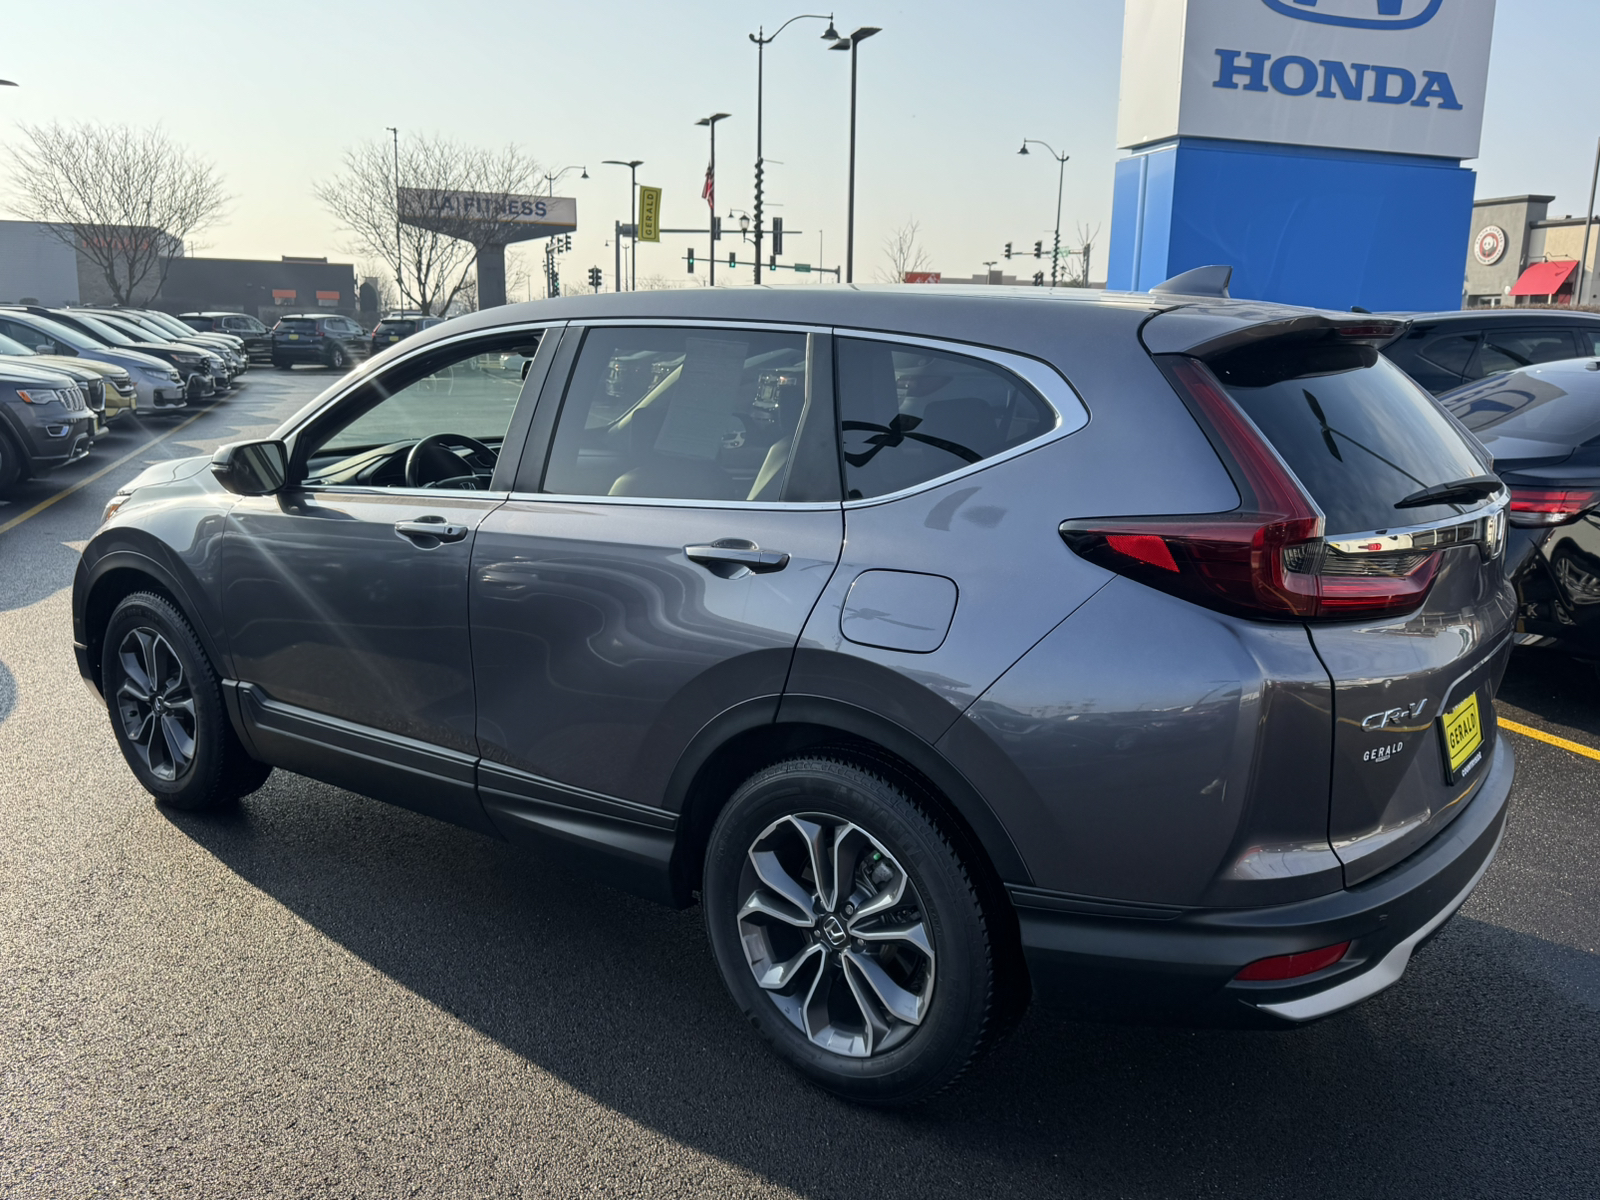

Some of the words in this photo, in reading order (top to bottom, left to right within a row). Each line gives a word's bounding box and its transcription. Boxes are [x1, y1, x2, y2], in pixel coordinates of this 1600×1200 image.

[1212, 48, 1463, 111] HONDA
[428, 197, 453, 212] LA
[464, 197, 547, 217] FITNESS
[645, 193, 654, 236] GERALD
[1361, 698, 1428, 730] CR-V
[1449, 713, 1477, 749] GERALD
[1363, 742, 1403, 761] GERALD
